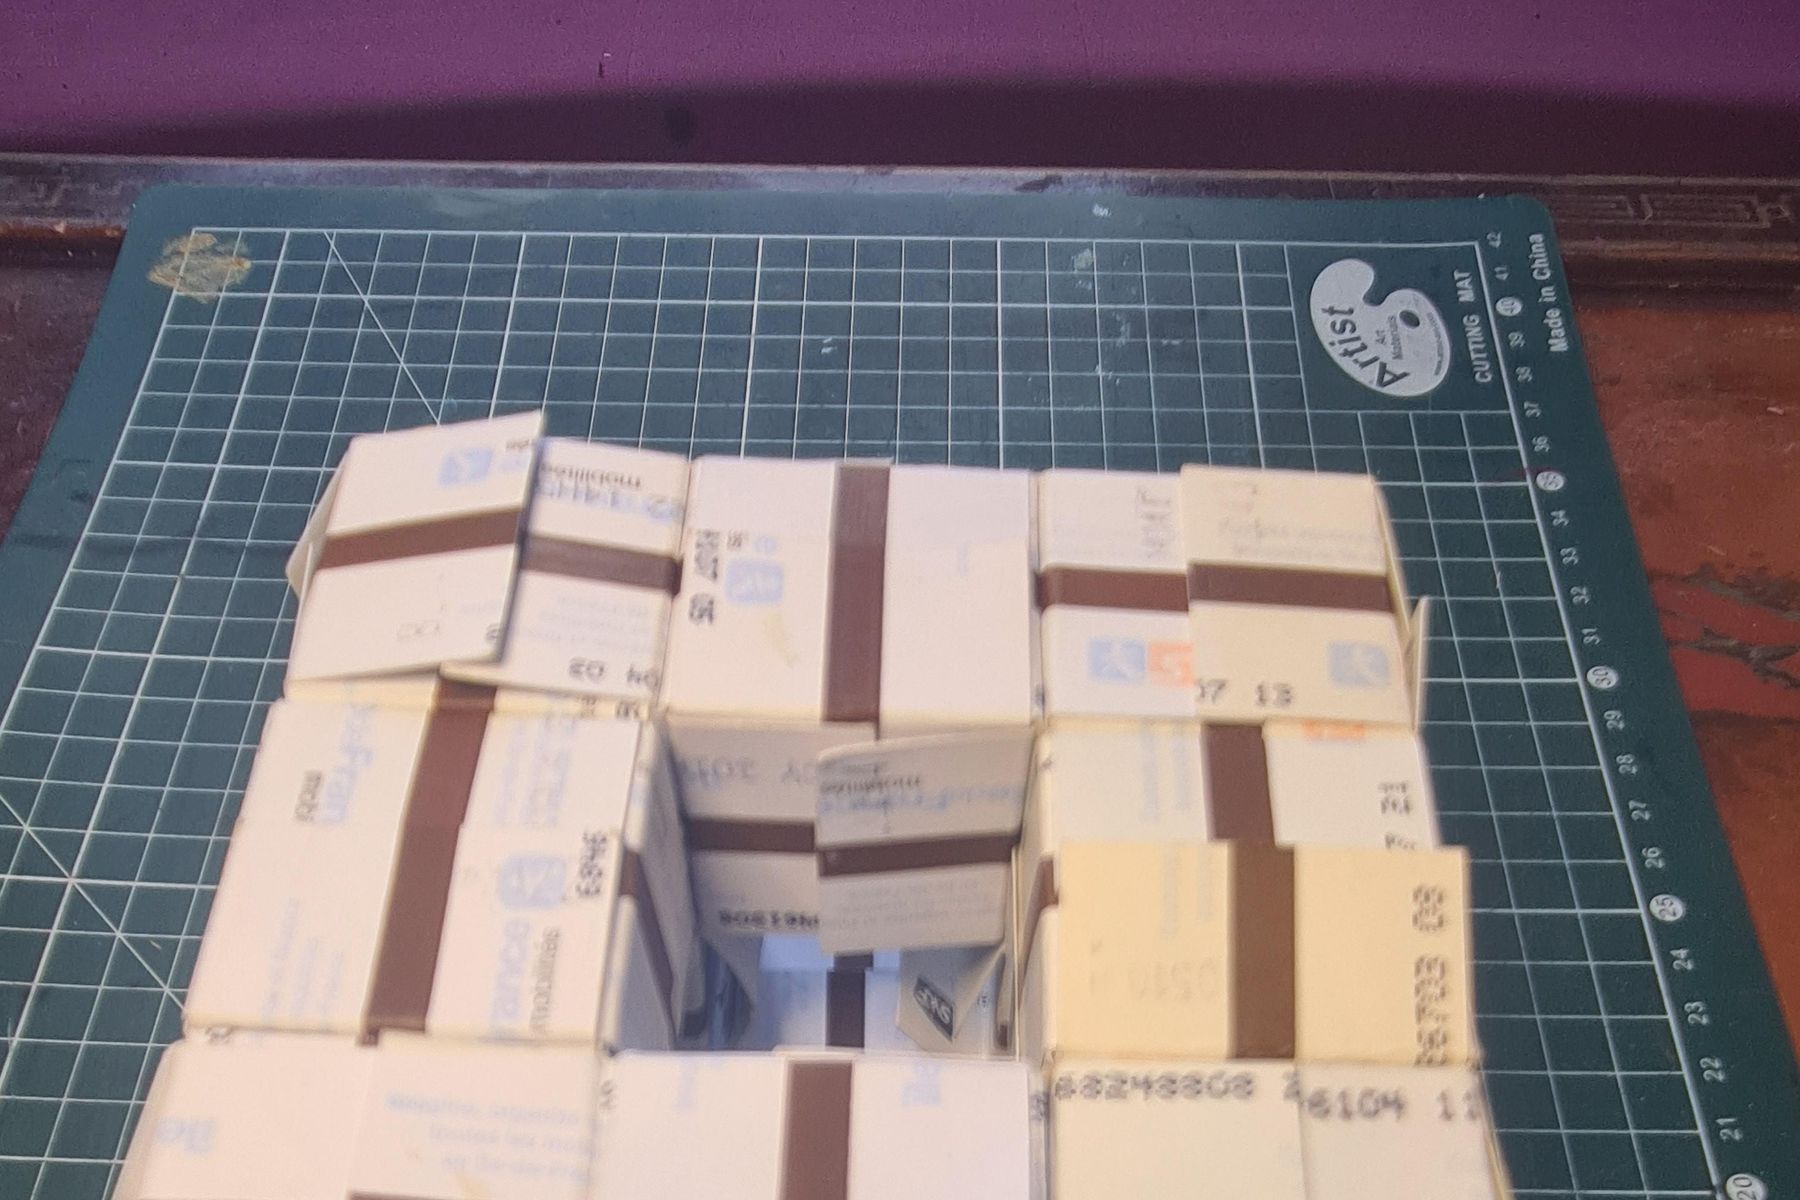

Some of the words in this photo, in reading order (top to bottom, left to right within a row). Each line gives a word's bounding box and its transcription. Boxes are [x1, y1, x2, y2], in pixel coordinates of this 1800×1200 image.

[1528, 233, 1551, 281] China
[1453, 269, 1476, 302] MAT
[1537, 285, 1558, 303] in
[1507, 330, 1526, 348] 39
[1543, 307, 1569, 352] Made
[1321, 305, 1410, 388] Artist
[1462, 313, 1492, 383] CUTTING
[1523, 400, 1542, 418] 37
[1531, 435, 1550, 452] 36
[1550, 508, 1570, 527] 34
[1560, 547, 1579, 566] 33
[1570, 585, 1590, 605] 32
[1581, 627, 1601, 646] 31
[1590, 666, 1612, 688] 30
[1603, 709, 1625, 732] 29
[1615, 753, 1638, 776] 28
[1628, 799, 1651, 822] 27
[1641, 846, 1665, 870] 26
[1654, 895, 1678, 920] 25
[1669, 947, 1694, 971] 24
[1683, 1000, 1709, 1026] 23
[1699, 1055, 1727, 1084] 22
[1715, 1116, 1744, 1142] 21
